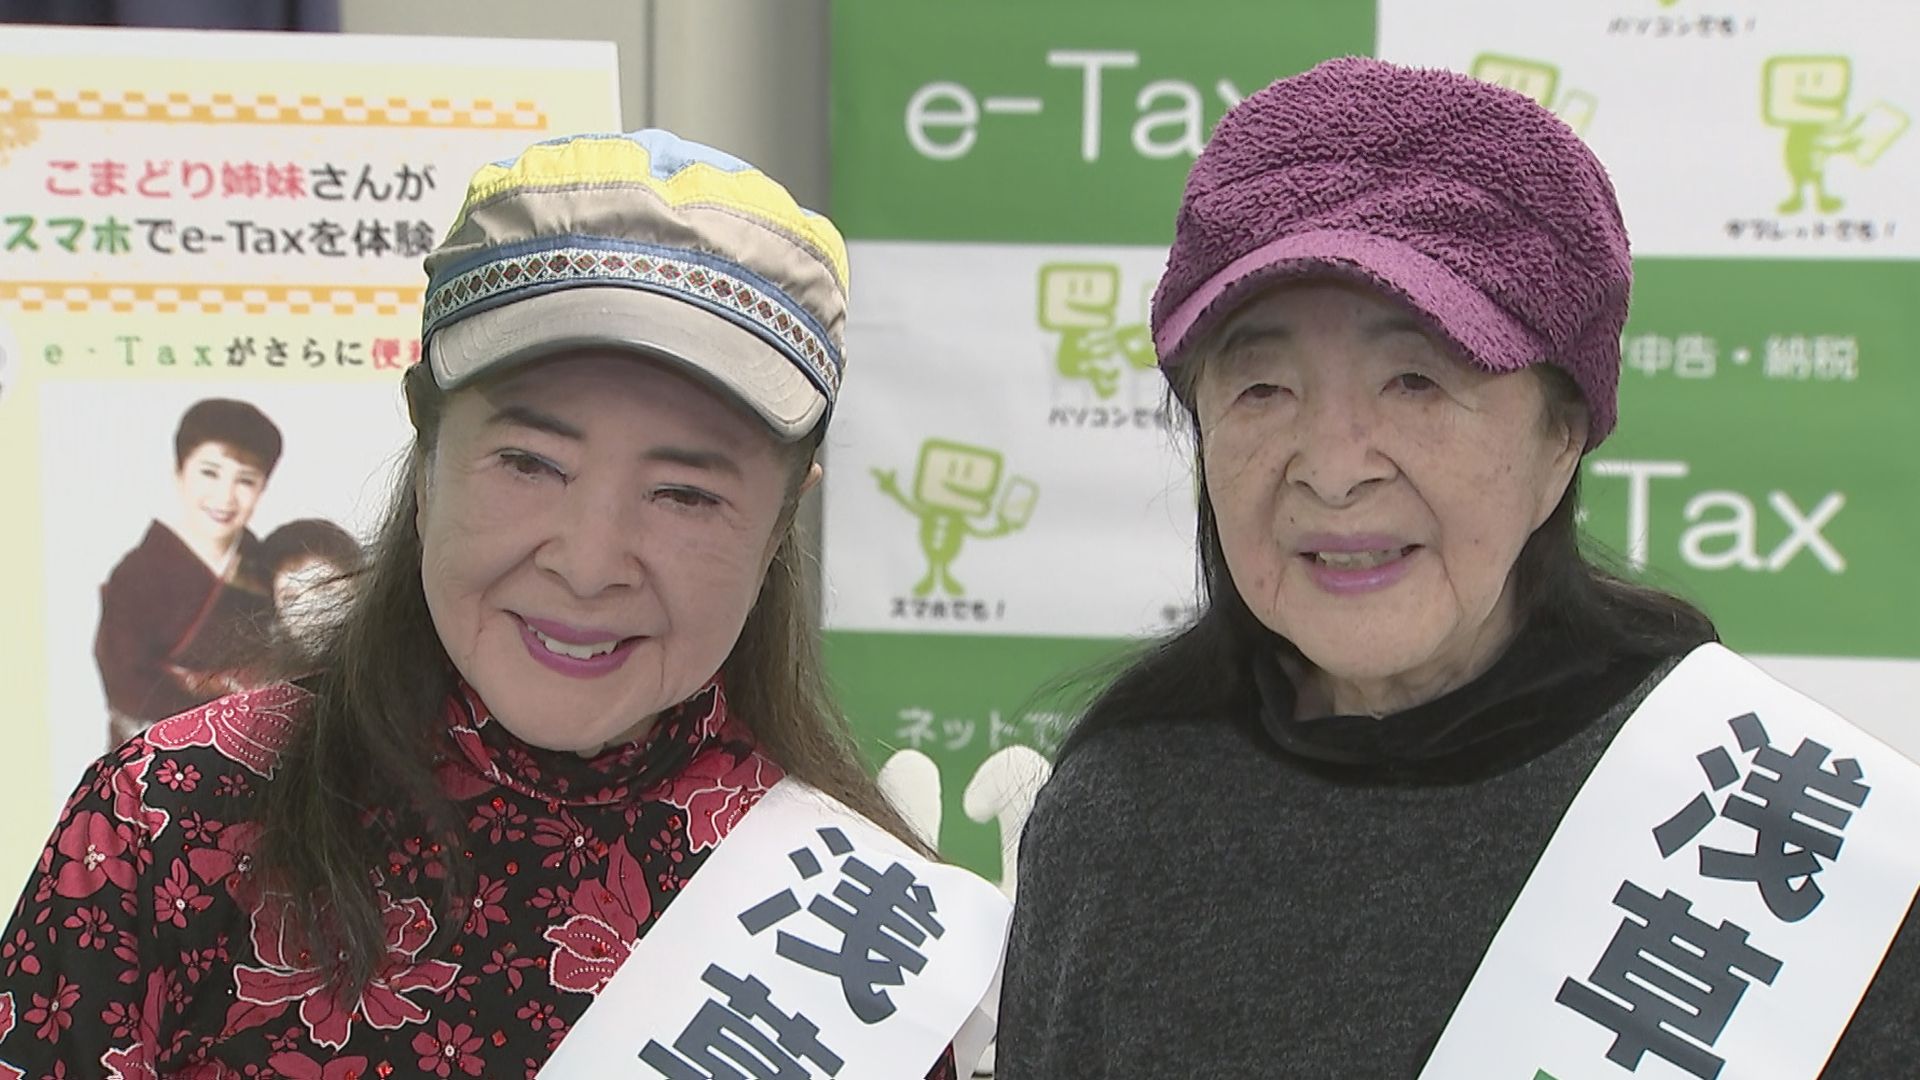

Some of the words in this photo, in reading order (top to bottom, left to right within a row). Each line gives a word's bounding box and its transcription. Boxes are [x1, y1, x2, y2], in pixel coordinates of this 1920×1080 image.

[3, 215, 434, 257] スマホでe-Taxを体験
[45, 160, 436, 201] こまどり姉妹さんが
[1574, 459, 1847, 573] Tax
[1554, 711, 1872, 1080] 浅草
[637, 826, 945, 1080] 浅草
